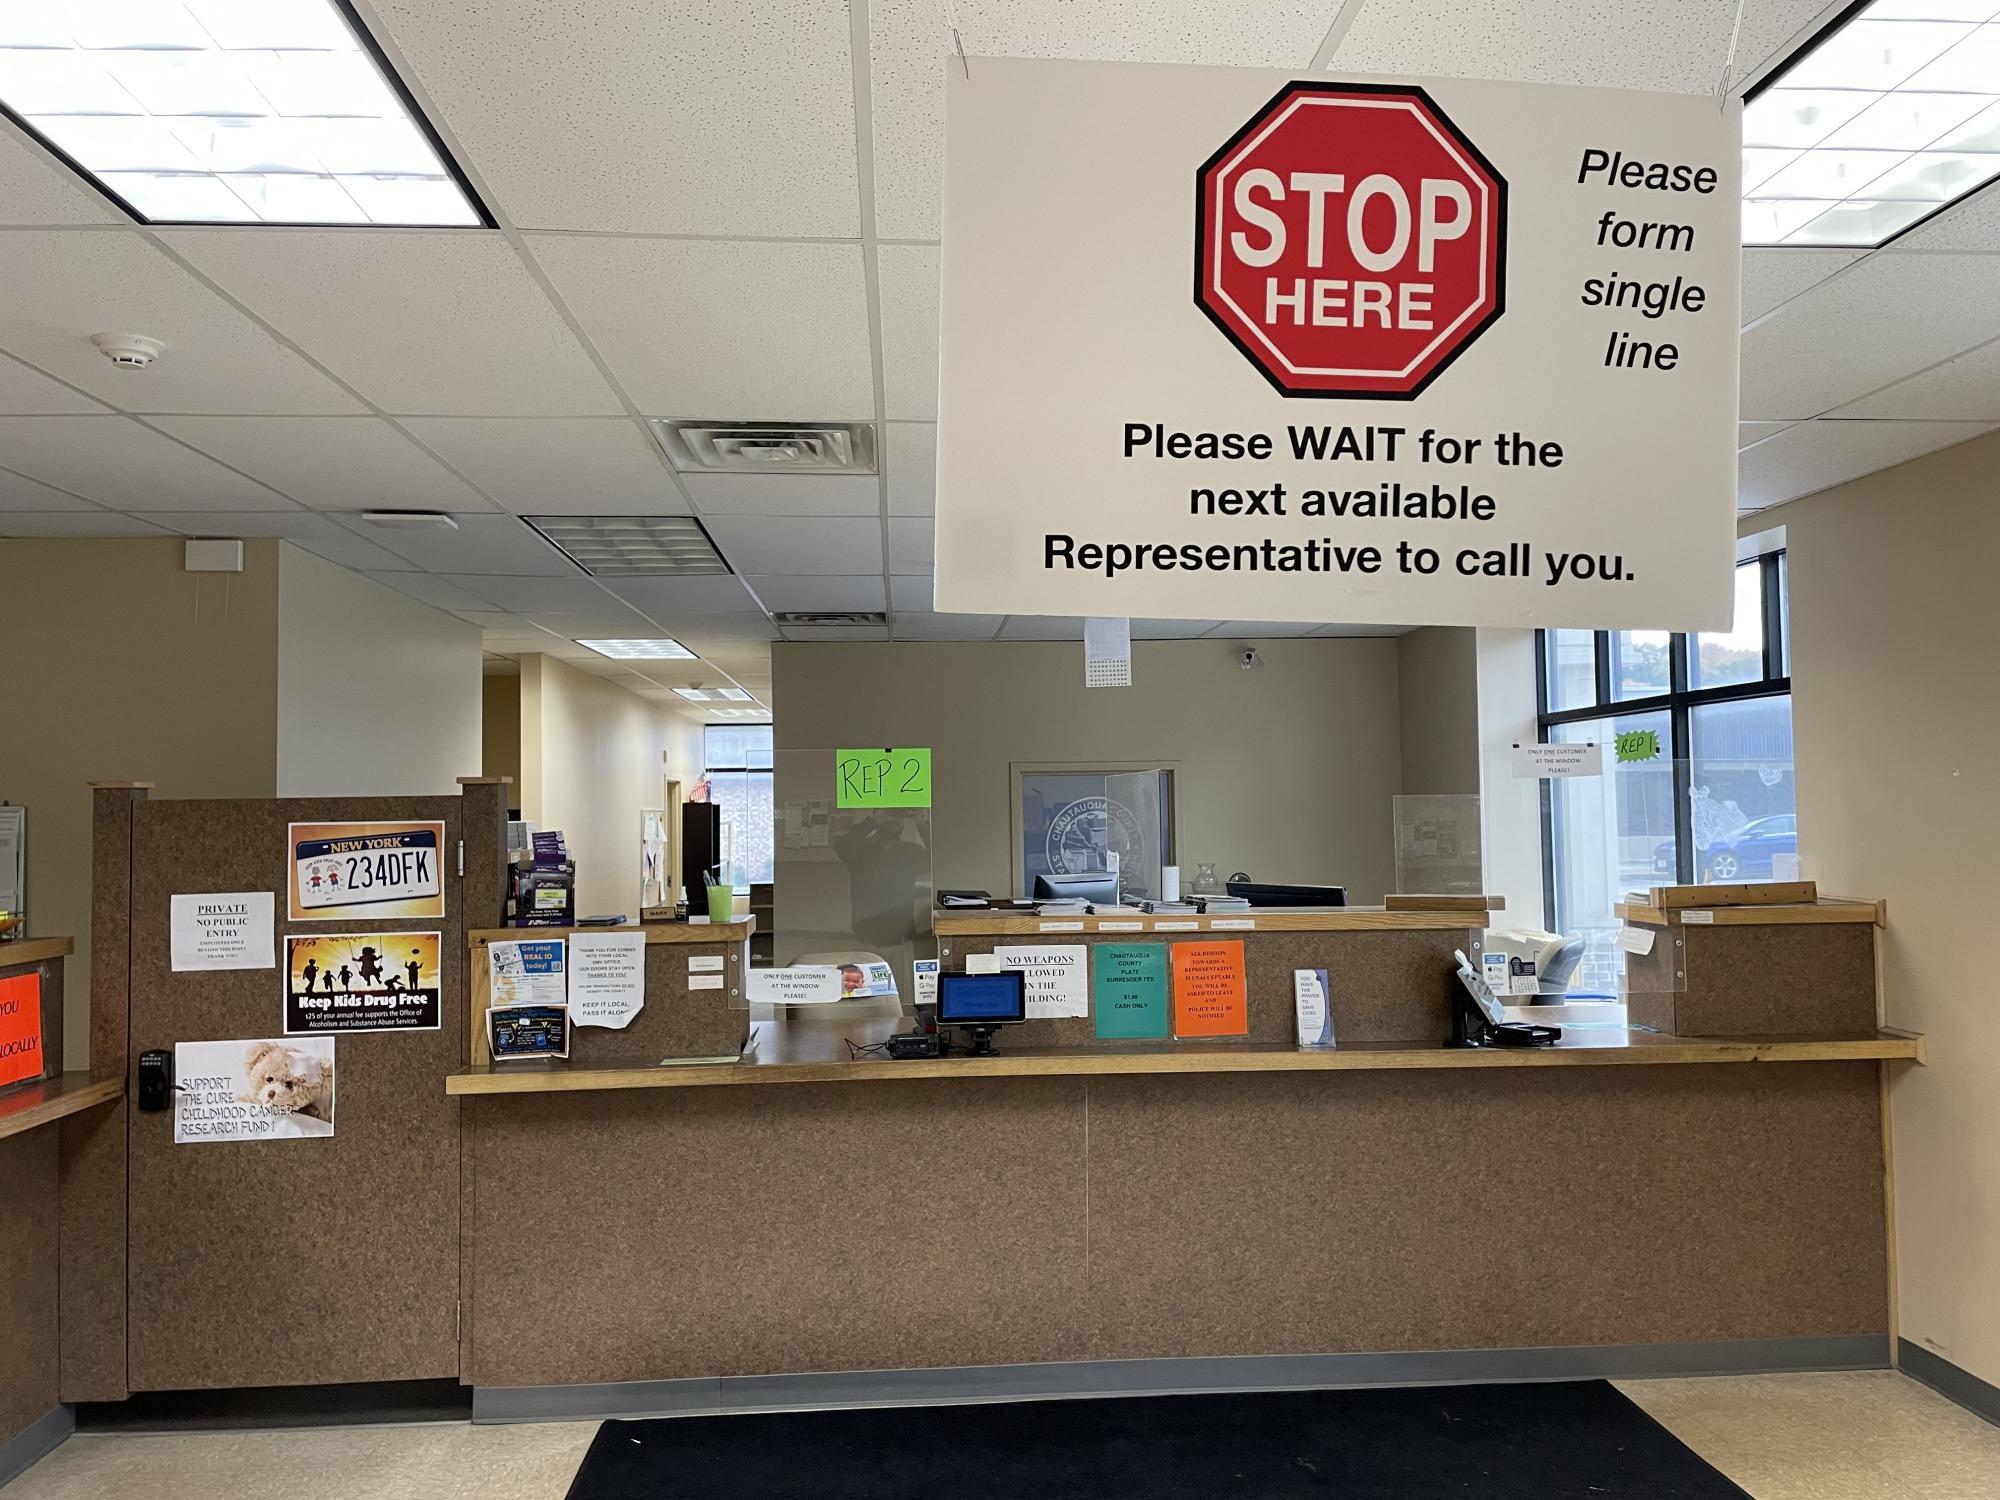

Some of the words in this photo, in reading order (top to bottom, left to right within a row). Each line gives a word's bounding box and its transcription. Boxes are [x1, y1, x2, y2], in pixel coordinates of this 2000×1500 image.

[1577, 149, 1717, 194] Please
[1231, 168, 1472, 273] STOP
[1597, 211, 1694, 252] form
[1581, 271, 1705, 319] single
[1265, 277, 1434, 331] HERE
[1604, 331, 1678, 370] line
[1124, 423, 1272, 460] Please
[1287, 426, 1405, 462] WAIT
[1418, 428, 1482, 464] for
[1494, 432, 1564, 468] the
[1190, 483, 1287, 515] next
[1301, 483, 1496, 520] available
[1044, 534, 1382, 577] Representative
[1396, 541, 1440, 574] to
[1455, 543, 1531, 577] call
[1545, 552, 1634, 586] you.
[1621, 736, 1644, 754] REP
[838, 758, 892, 799] REP
[900, 758, 924, 792] 2
[330, 841, 363, 854] NEW
[366, 837, 402, 849] YORK
[346, 851, 430, 890] 234DFK
[198, 904, 249, 914] PRIVATE
[213, 918, 249, 926] PUBLIC
[206, 929, 239, 937] ENTRY
[535, 945, 551, 953] your
[526, 962, 548, 970] today!
[1006, 956, 1021, 965] NO
[1024, 955, 1074, 964] WEAPONS
[1025, 982, 1034, 990] IN
[0, 1000, 20, 1016] YOU
[299, 996, 332, 1011] Keep
[334, 994, 361, 1007] Kids
[364, 994, 397, 1008] Drug
[399, 993, 428, 1005] Free
[364, 1011, 388, 1019] supports
[0, 1036, 38, 1058] LOCALLY
[182, 1077, 232, 1091] SUPPORT
[181, 1093, 203, 1106] THE
[206, 1092, 235, 1105] CURE
[181, 1106, 246, 1121] CHILDHOOD
[250, 1104, 294, 1118] CANCER
[181, 1121, 239, 1136] RESEARCH
